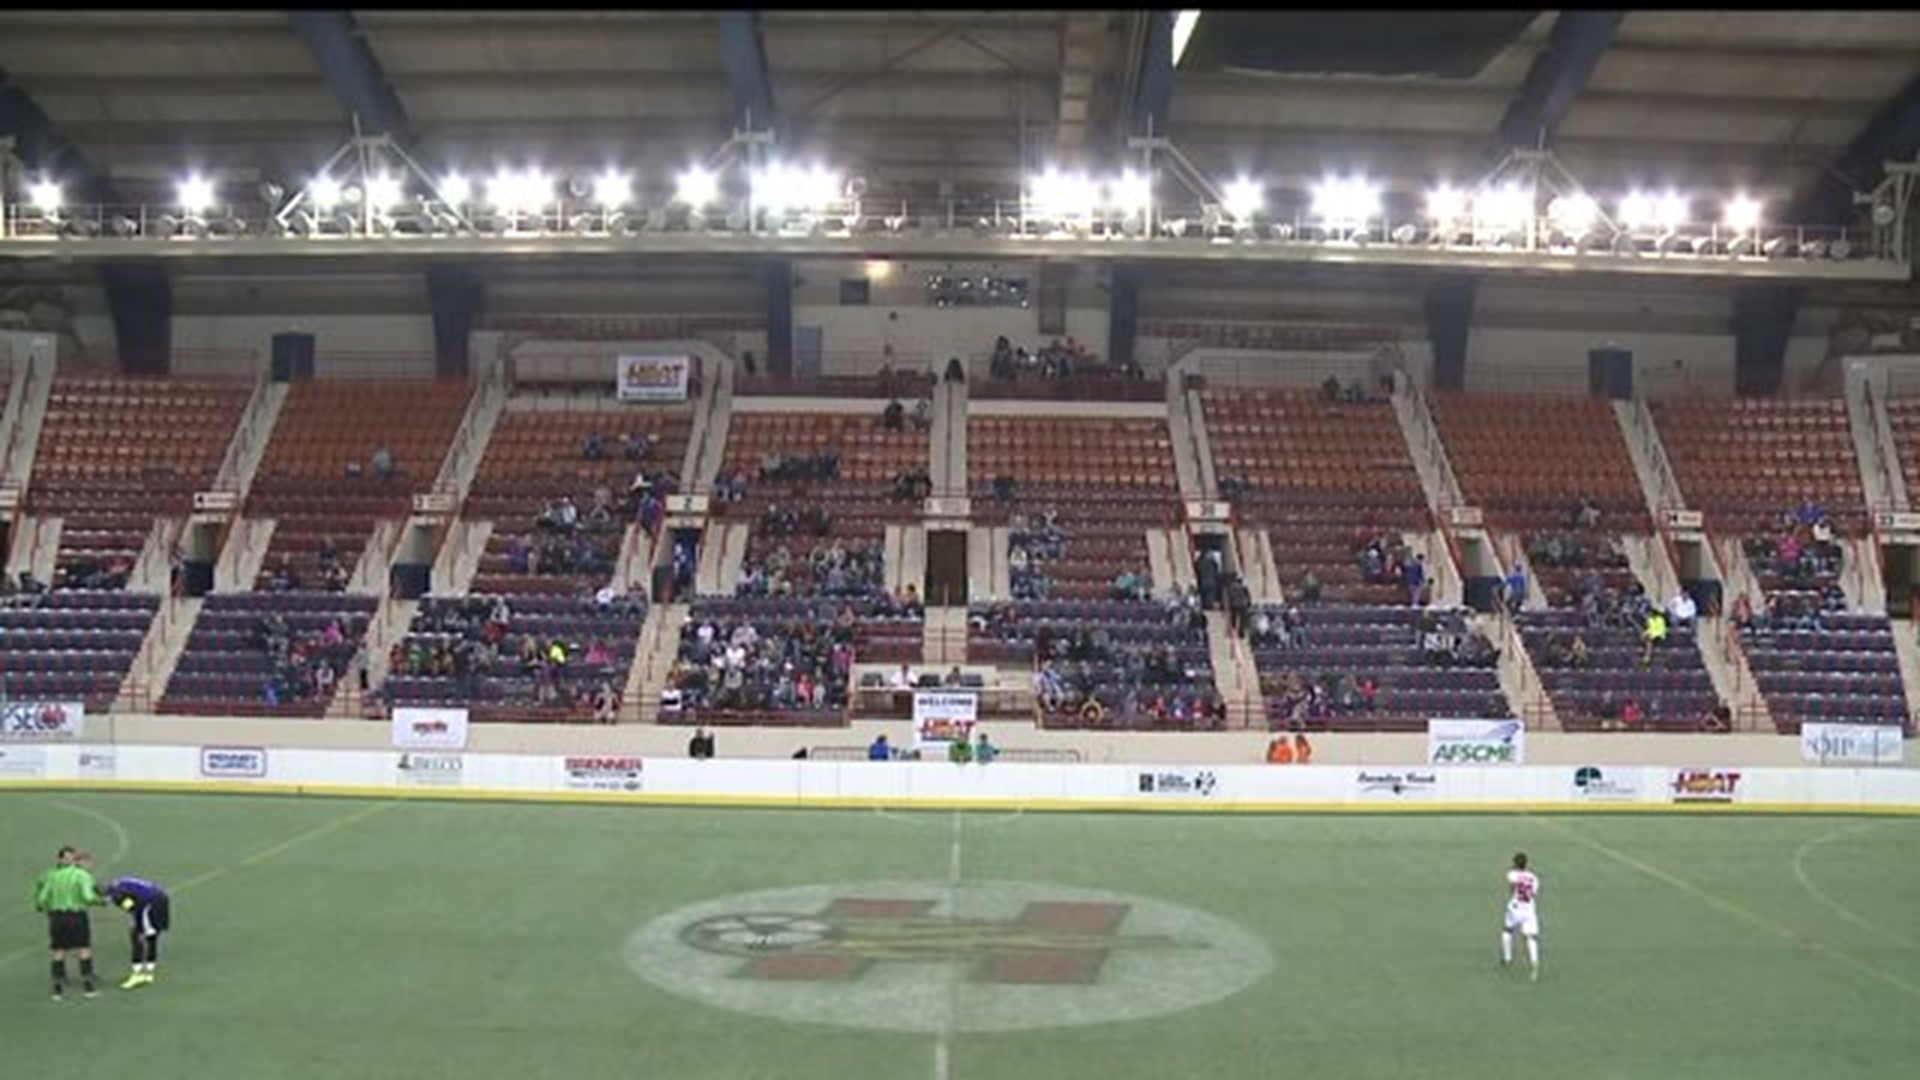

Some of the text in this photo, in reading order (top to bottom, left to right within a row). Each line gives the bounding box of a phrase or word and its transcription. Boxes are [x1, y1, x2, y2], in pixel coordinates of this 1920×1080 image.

[918, 697, 972, 706] WELCOME
[1433, 743, 1517, 762] AFSCME
[565, 758, 642, 771] BRENNER
[1673, 771, 1740, 793] HEAT
